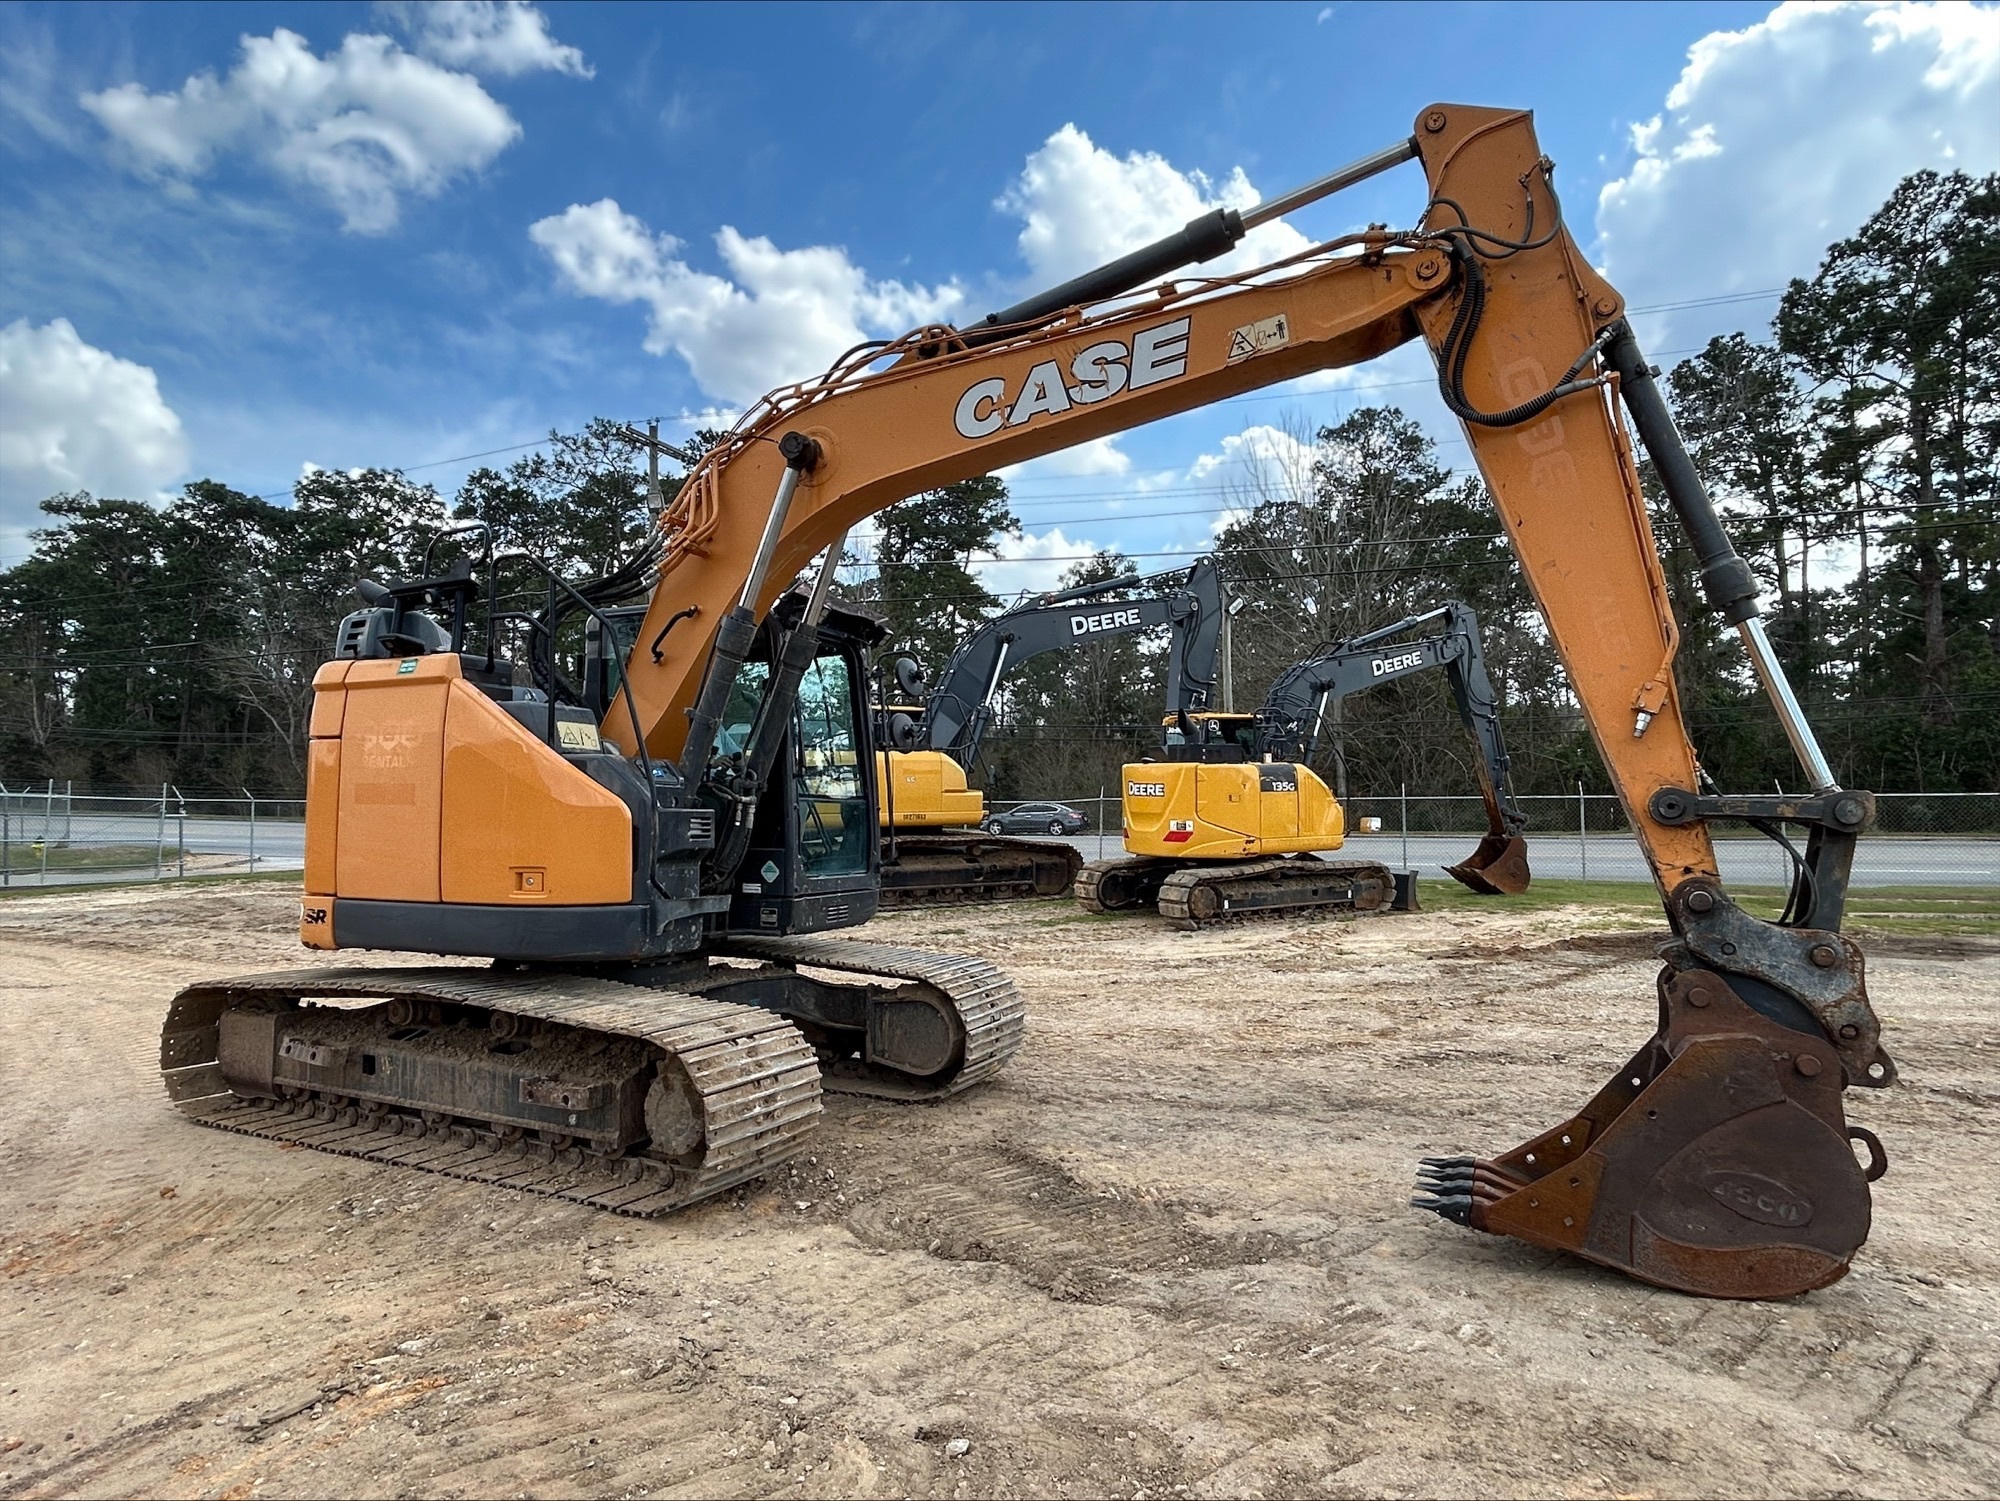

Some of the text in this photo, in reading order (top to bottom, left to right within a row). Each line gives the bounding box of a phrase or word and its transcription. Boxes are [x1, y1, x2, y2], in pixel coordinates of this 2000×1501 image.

[954, 315, 1192, 439] CASE
[1070, 608, 1141, 636] DEERE
[1371, 651, 1423, 677] DEERE
[1128, 781, 1165, 797] DEERE
[1272, 781, 1295, 792] 135G
